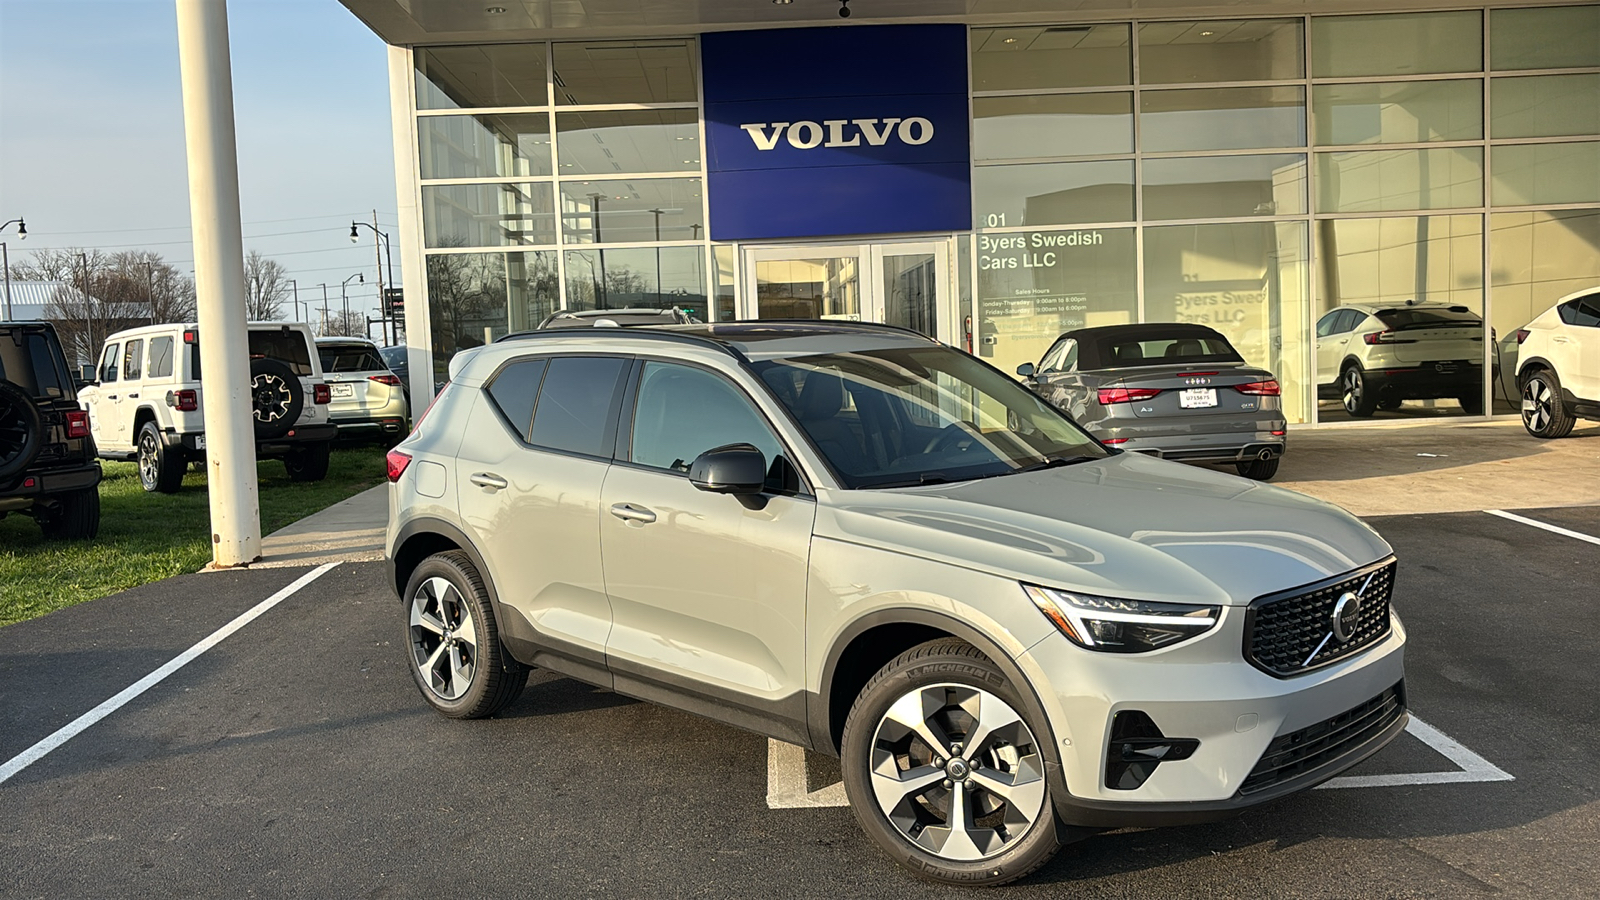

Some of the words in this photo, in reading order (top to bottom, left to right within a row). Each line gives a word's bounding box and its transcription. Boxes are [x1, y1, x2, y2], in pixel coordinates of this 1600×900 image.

[740, 117, 934, 150] VOLVO
[980, 236, 1026, 253] Byers
[1031, 231, 1103, 248] Swedish
[979, 255, 1018, 270] Cars
[1023, 252, 1056, 268] LLC
[922, 662, 986, 680] MICHELIN
